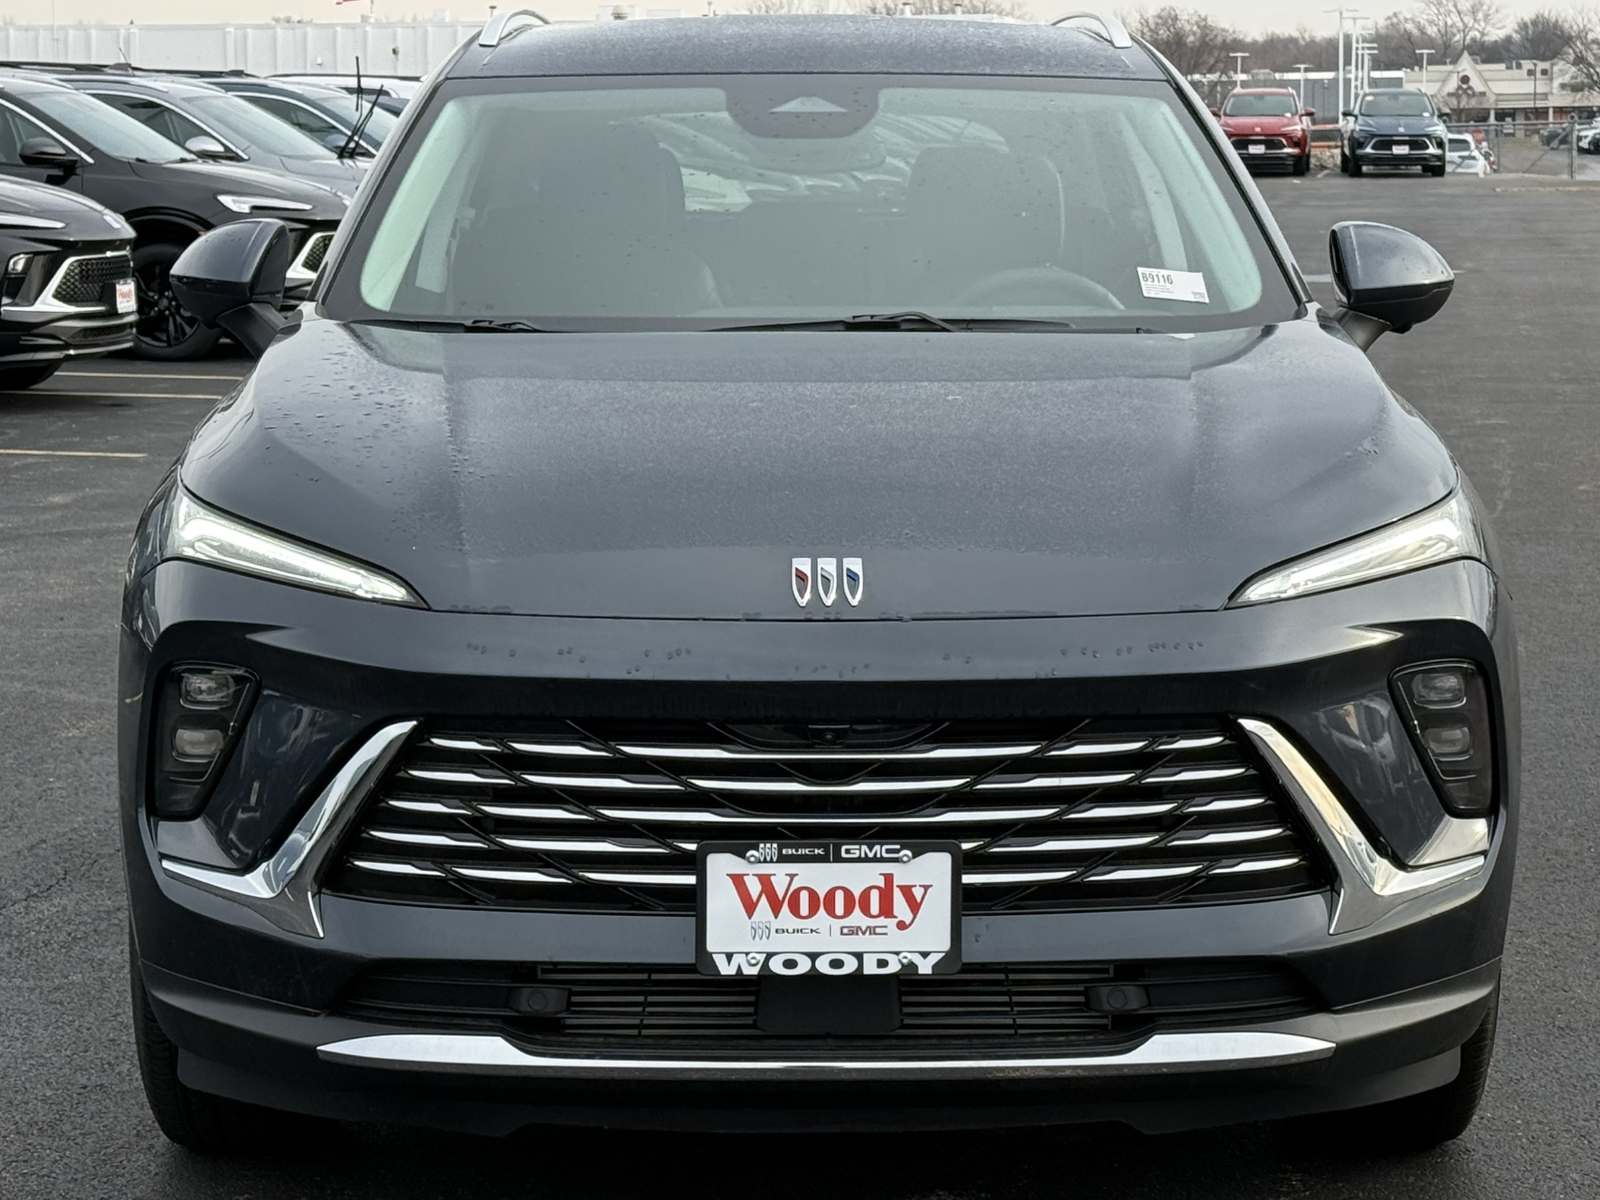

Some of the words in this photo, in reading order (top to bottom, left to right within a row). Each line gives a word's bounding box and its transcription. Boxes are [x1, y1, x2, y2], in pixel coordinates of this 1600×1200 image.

[1141, 272, 1173, 284] B9116
[840, 844, 901, 858] GMC
[726, 873, 933, 931] Woody
[840, 925, 889, 936] GMC
[711, 953, 946, 975] WOODY
